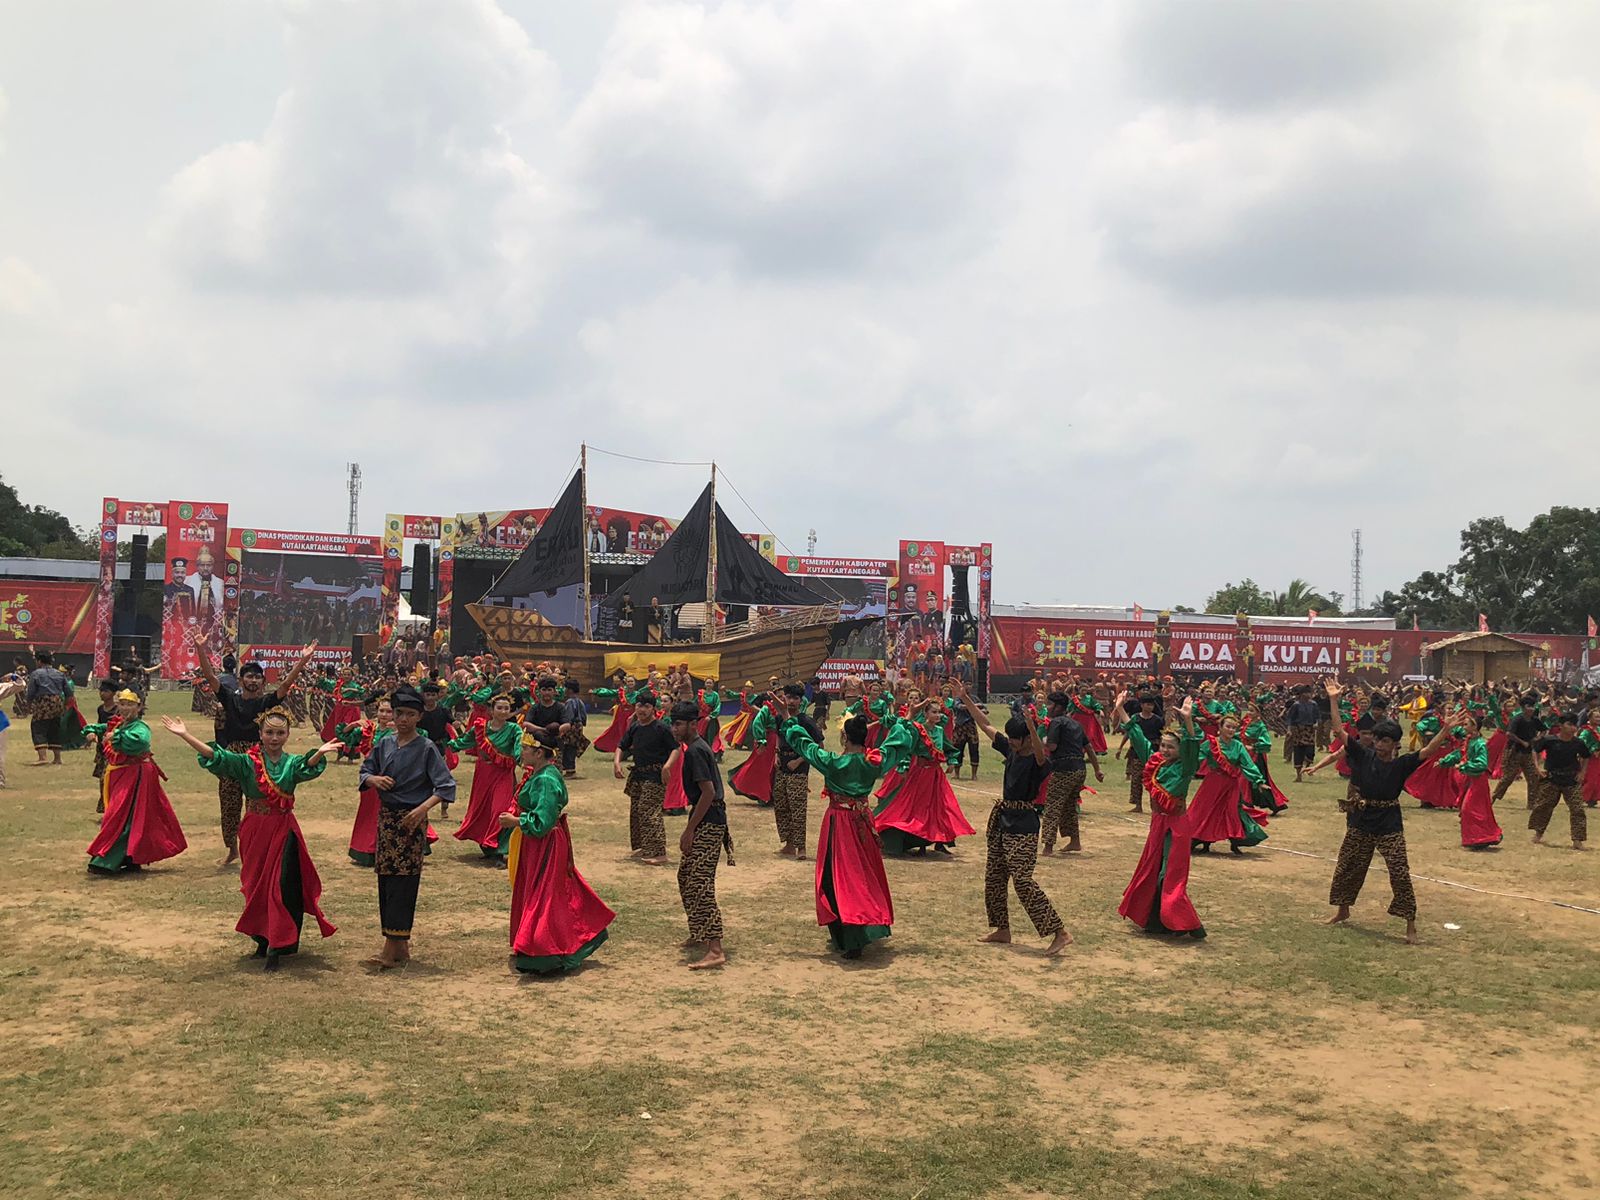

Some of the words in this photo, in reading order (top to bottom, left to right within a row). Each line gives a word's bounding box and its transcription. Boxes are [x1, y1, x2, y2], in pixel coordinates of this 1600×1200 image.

[257, 531, 277, 540] DINAS
[277, 533, 315, 543] PENDIDIKAN
[315, 535, 329, 544] DAN
[329, 536, 371, 546] KEBUDAYAAN
[281, 541, 301, 550] KUTAI
[301, 543, 346, 552] KARTANEGARA
[801, 558, 846, 567] PEMERINTAH
[846, 560, 887, 568] KABUPATEN
[807, 565, 829, 574] KUTAI
[829, 567, 881, 576] KARTANEGARA
[1095, 628, 1135, 638] PEMERINTAH
[1171, 631, 1190, 640] KUTAI
[1190, 632, 1233, 641] KARTANEGARA
[1256, 634, 1291, 643] PENDIDIKAN
[1291, 635, 1304, 643] DAN
[1304, 636, 1341, 645] KEBUDAYAAN
[1095, 639, 1149, 660] ERA
[1179, 642, 1233, 662] ADA
[1263, 645, 1341, 665] KUTAI
[828, 663, 875, 671] KEBUDAYAAN
[1095, 660, 1143, 670] MEMAJUKAN
[1298, 666, 1340, 675] NUSANTARA
